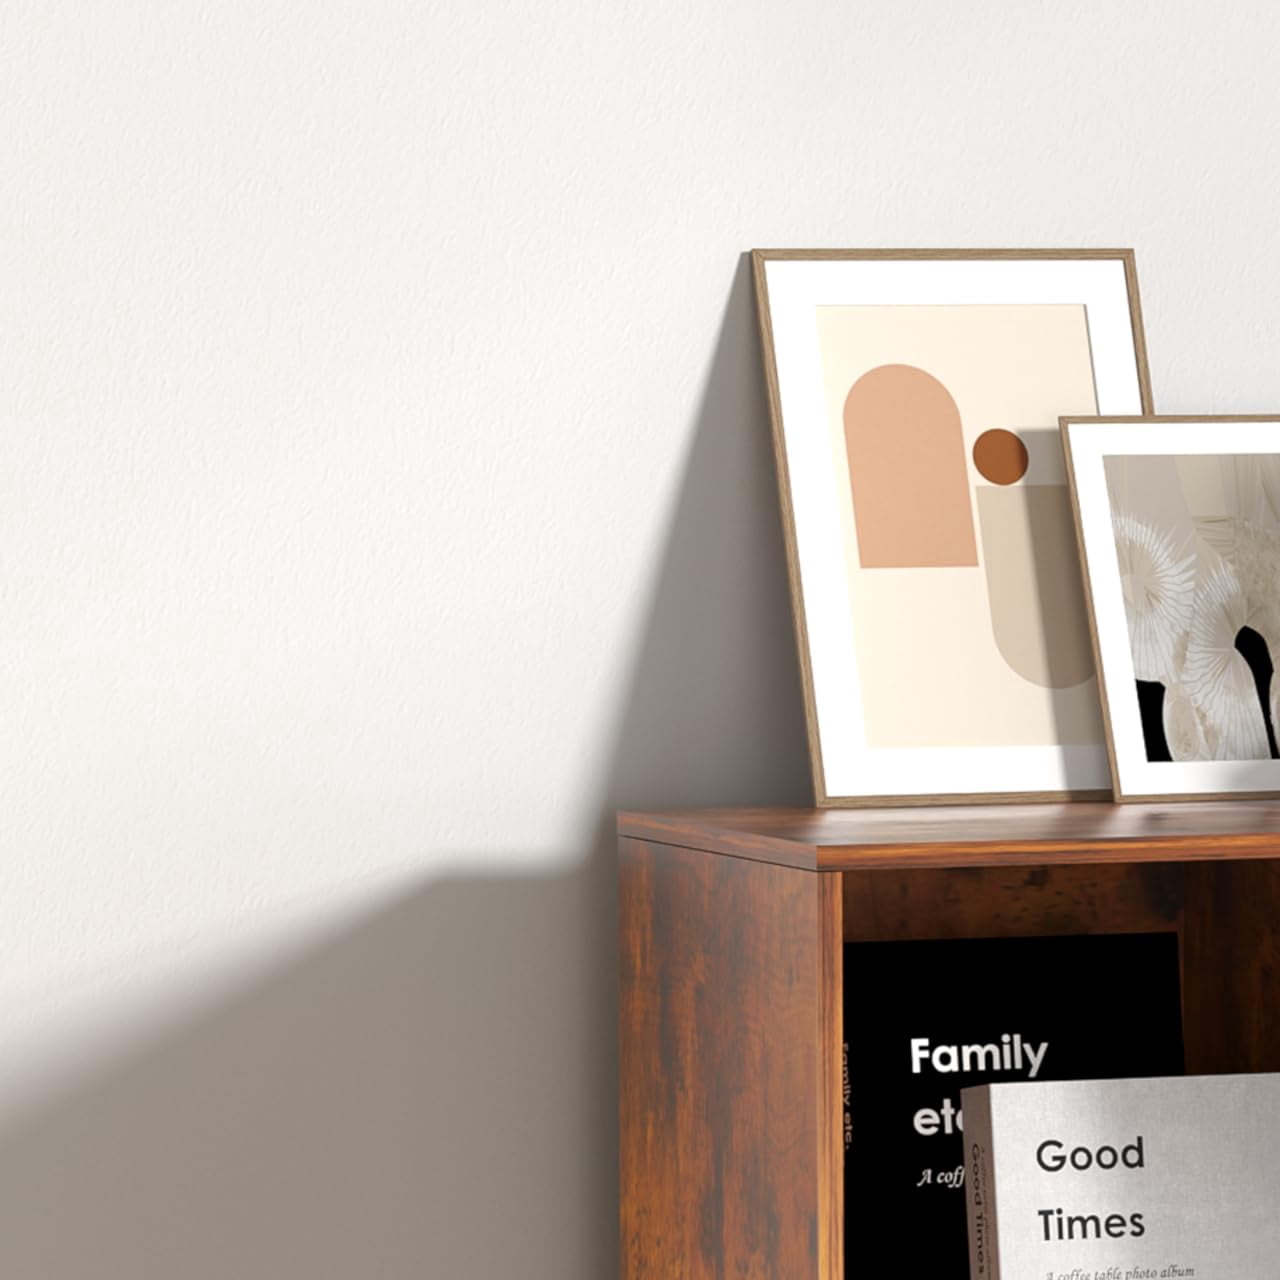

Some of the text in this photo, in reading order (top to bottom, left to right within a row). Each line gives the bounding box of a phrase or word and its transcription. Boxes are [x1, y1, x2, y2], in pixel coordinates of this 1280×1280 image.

[910, 1033, 1049, 1078] Family
[1036, 1136, 1145, 1172] Good
[916, 1168, 932, 1187] A
[972, 1143, 982, 1206] Good
[1037, 1208, 1145, 1241] Times
[1160, 1264, 1195, 1279] album
